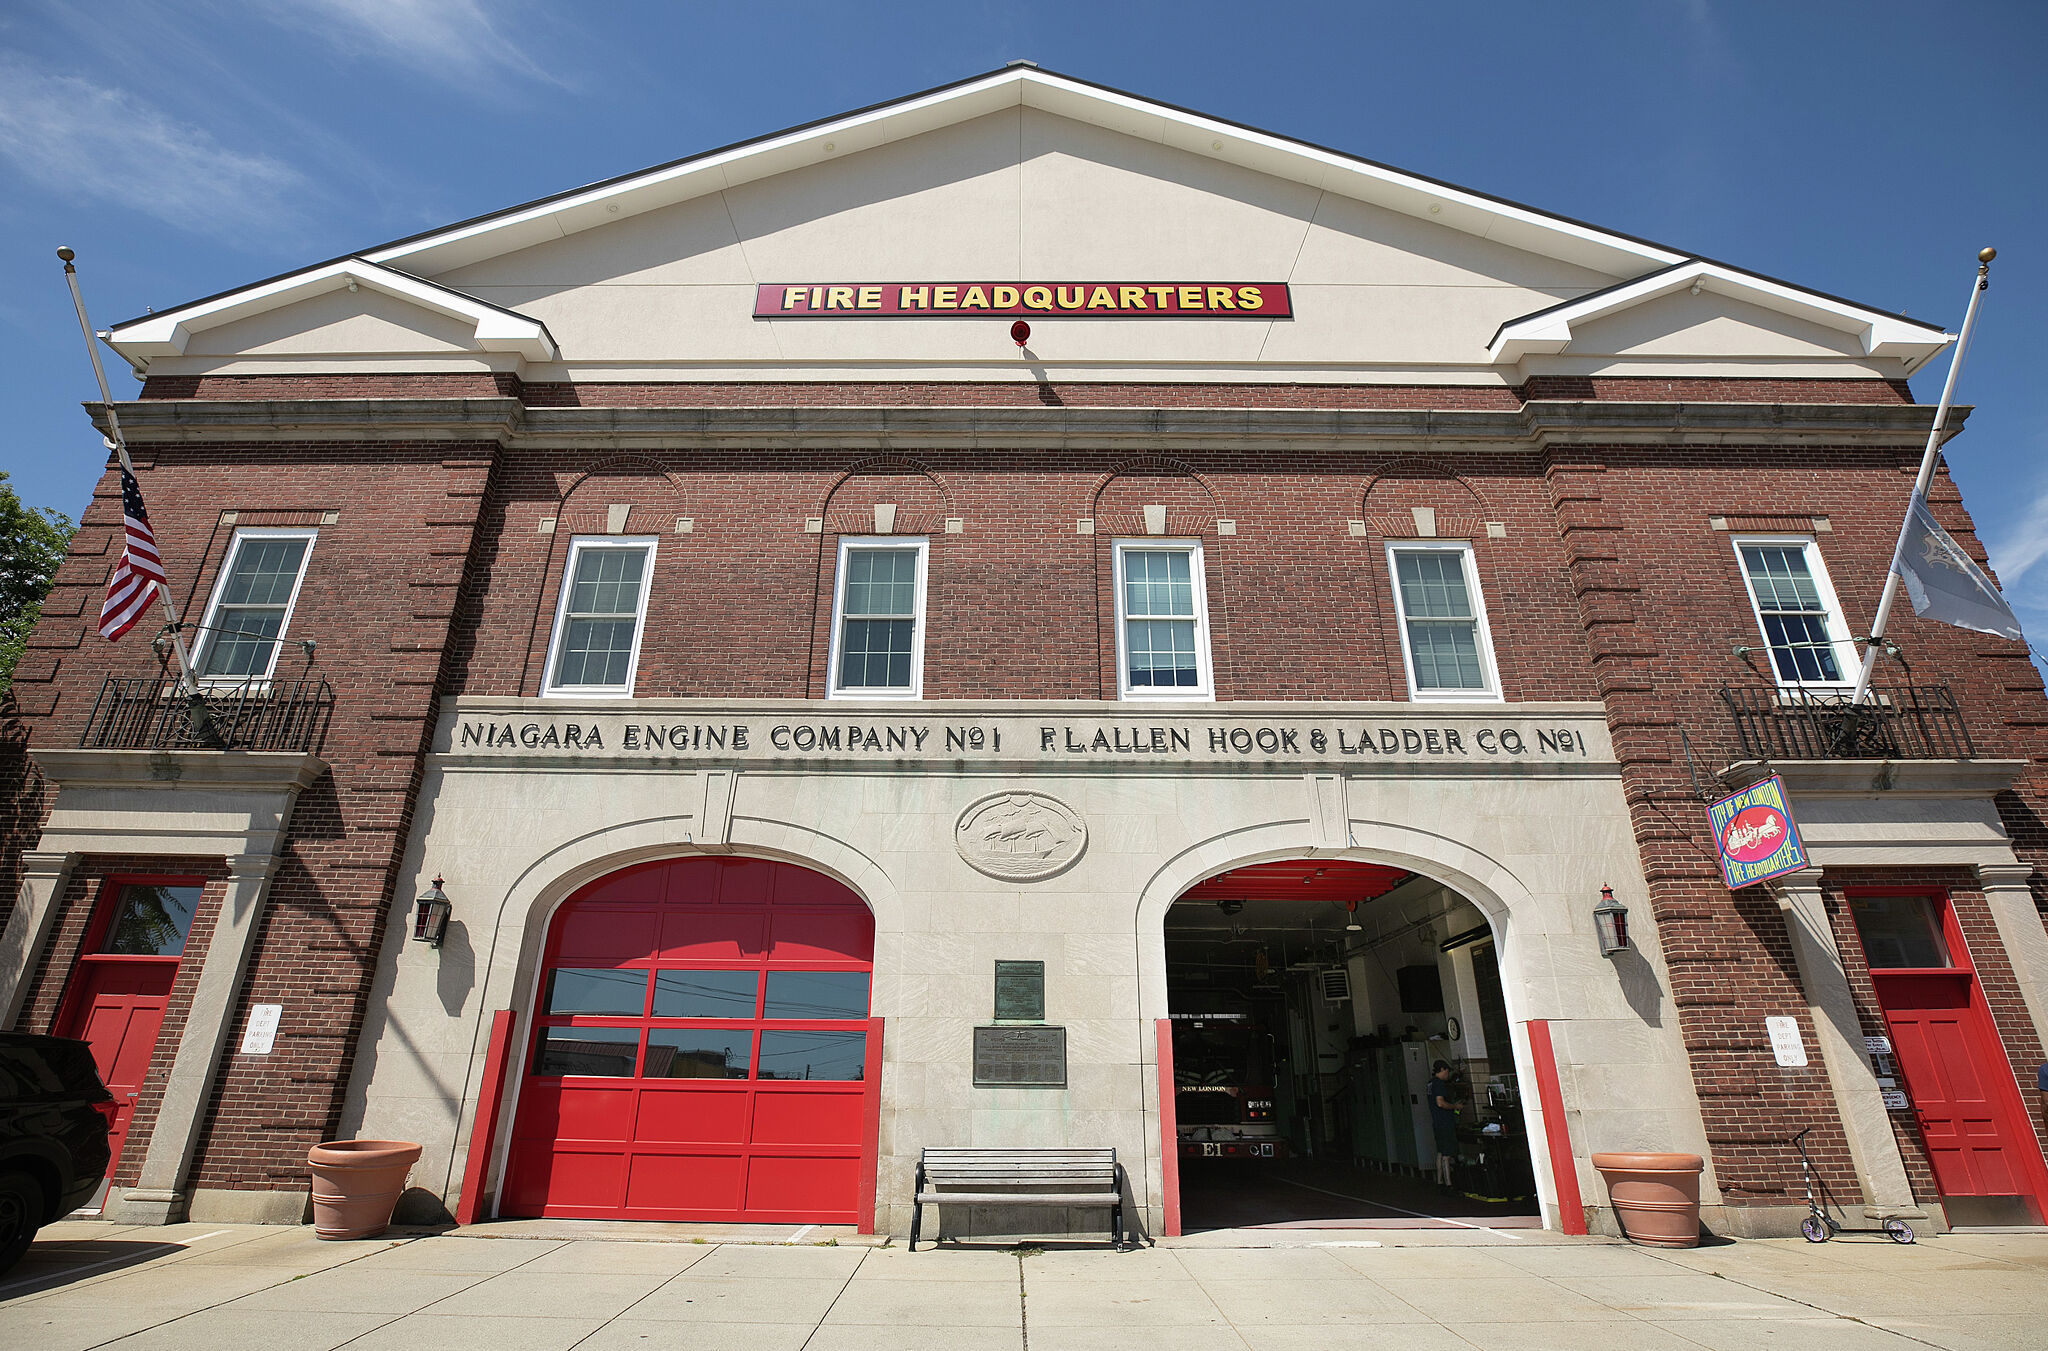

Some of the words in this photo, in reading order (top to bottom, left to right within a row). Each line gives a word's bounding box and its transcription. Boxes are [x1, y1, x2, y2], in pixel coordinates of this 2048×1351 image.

[782, 286, 882, 310] FIRE
[898, 285, 1264, 312] HEADQUARTERS
[460, 722, 604, 749] NIAGARA
[622, 724, 749, 750] ENGINE
[770, 725, 929, 751] COMPANY
[1208, 727, 1301, 754] HOOK
[1310, 728, 1328, 753] &
[1337, 728, 1468, 755] LADDER
[1477, 729, 1528, 755] CO.
[1710, 802, 1727, 842] CITY
[1725, 799, 1735, 818] OF
[1734, 792, 1750, 811] NEW
[1751, 780, 1787, 817] LONDON
[1723, 853, 1747, 885] FIRE
[1744, 828, 1801, 882] HEADQUARTERS
[1201, 1142, 1224, 1157] E1
